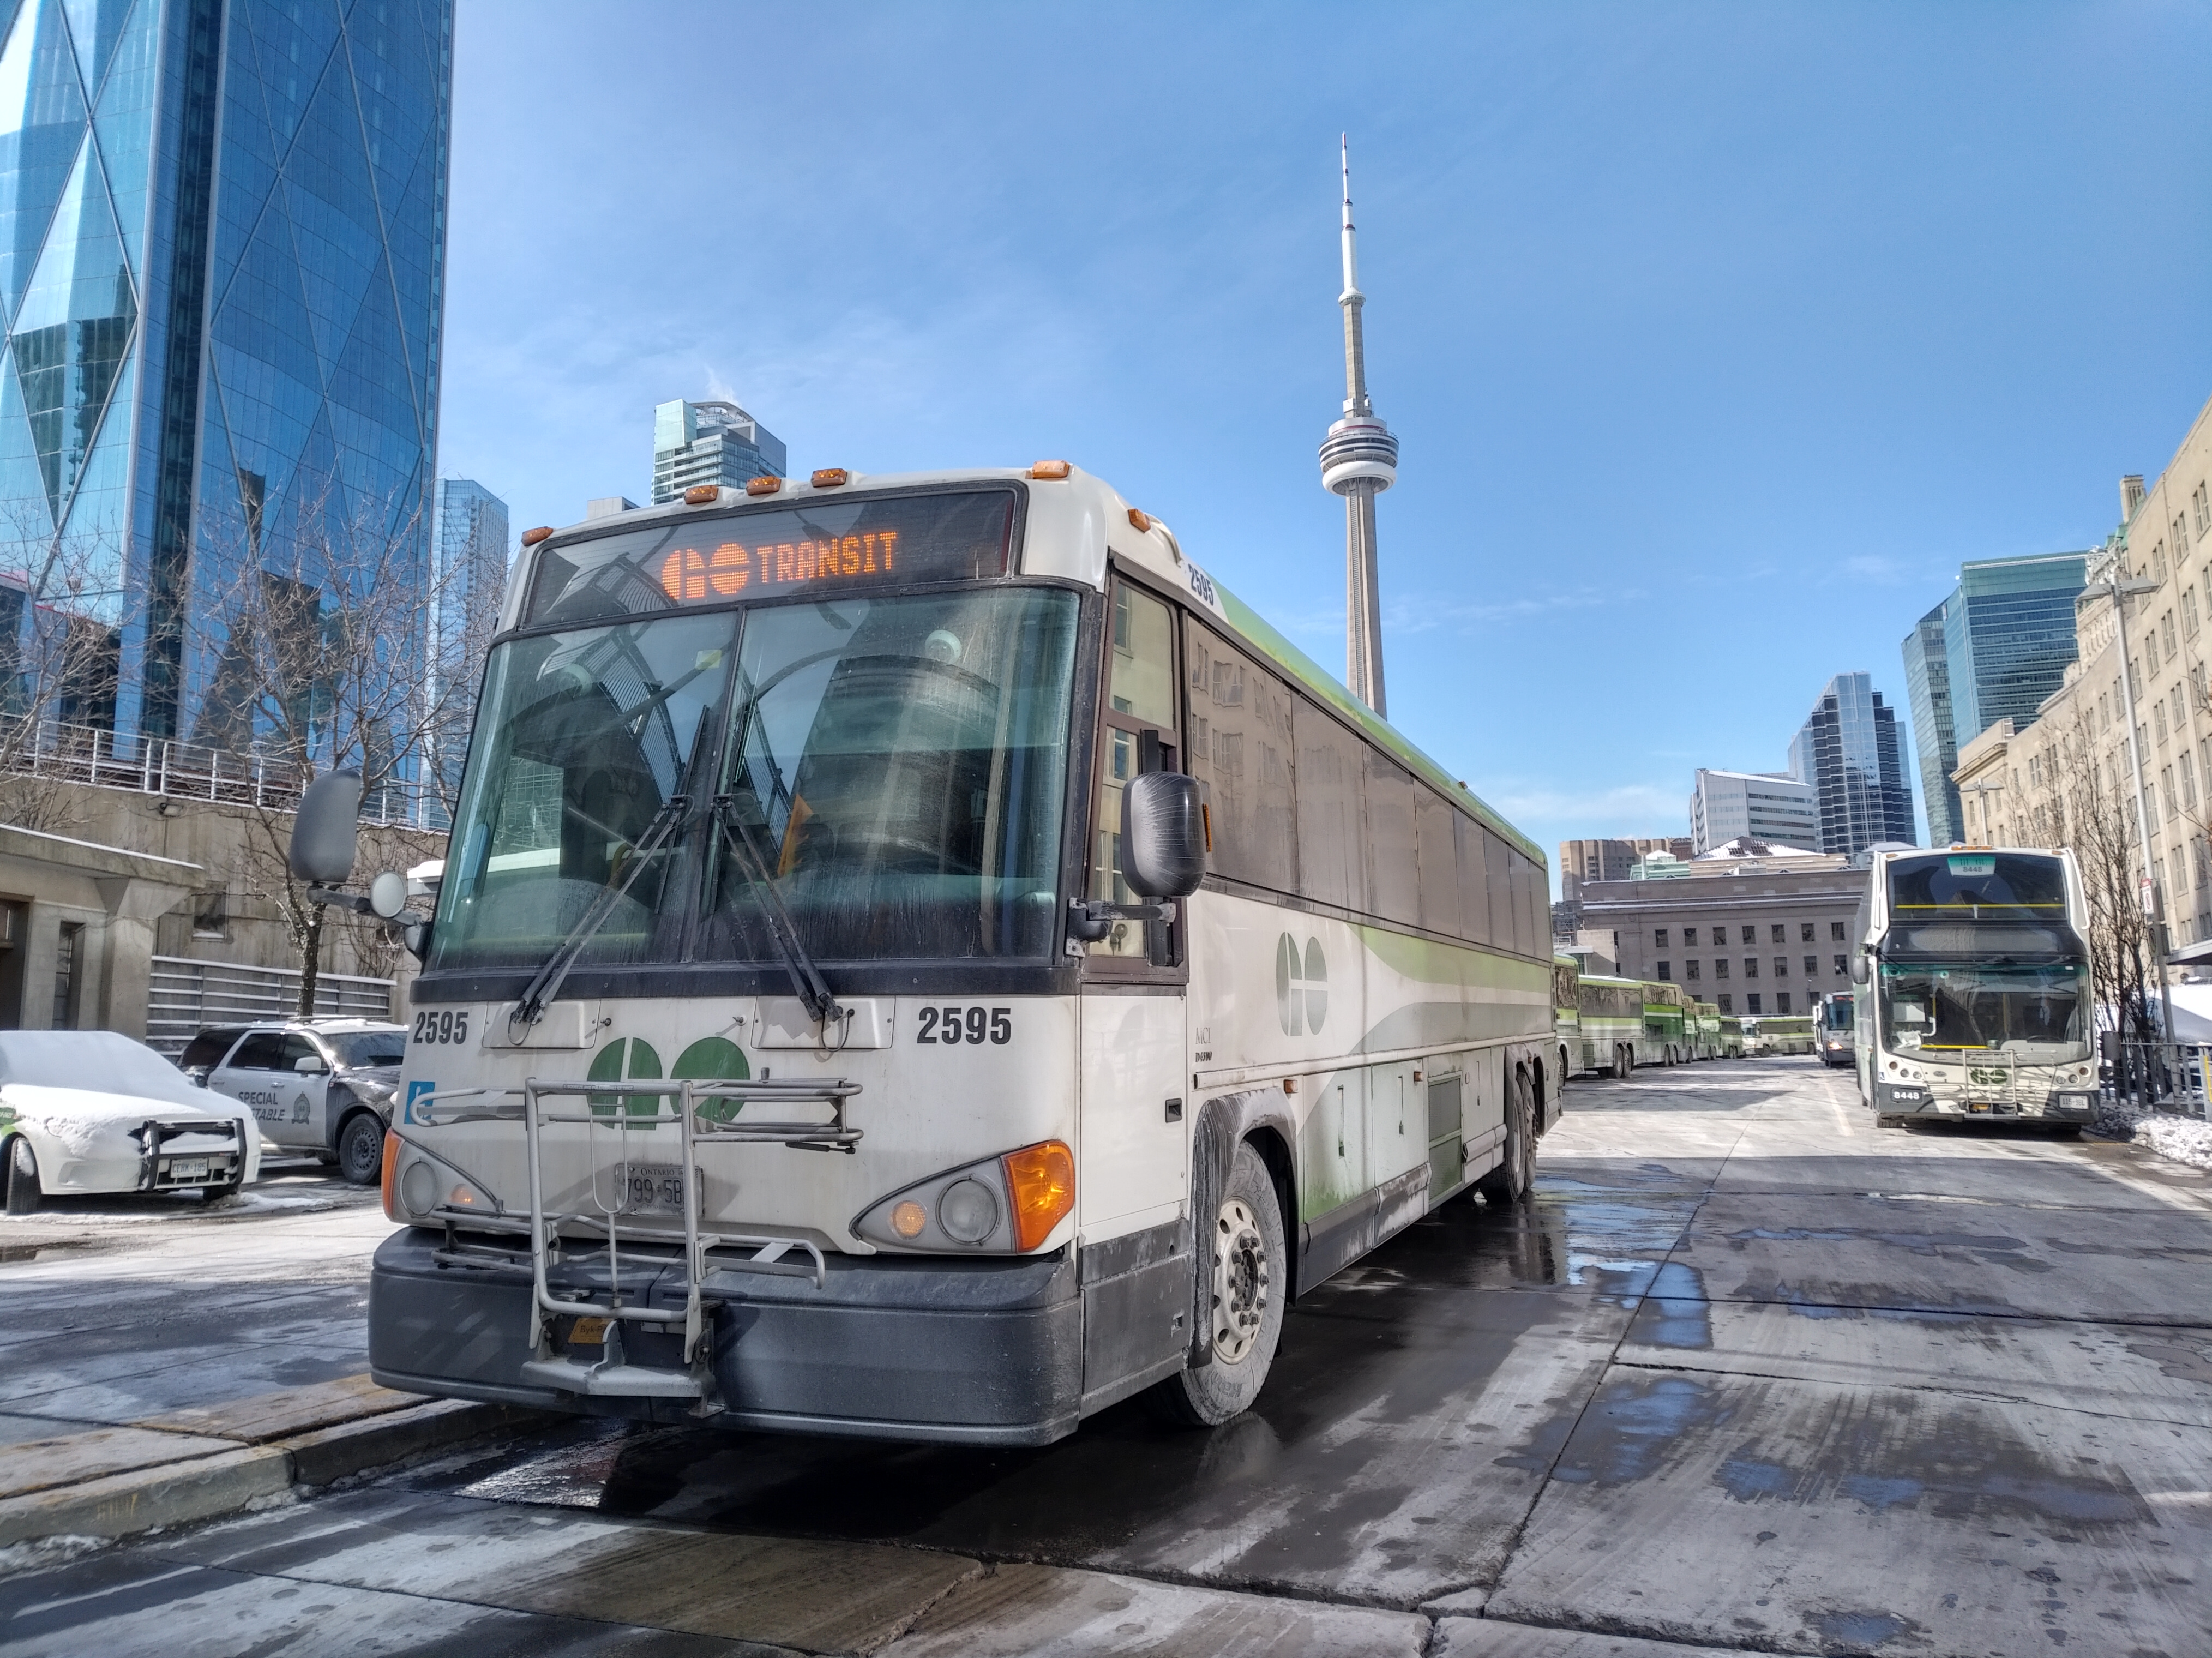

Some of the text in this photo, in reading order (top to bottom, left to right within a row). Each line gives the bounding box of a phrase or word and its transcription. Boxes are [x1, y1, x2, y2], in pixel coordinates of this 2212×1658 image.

[756, 531, 897, 584] TRANSIT
[1188, 563, 1214, 606] 2595
[413, 1011, 468, 1044] 2595
[917, 1006, 1011, 1045] 2595
[1195, 1027, 1211, 1044] MCI
[1195, 1051, 1212, 1062] D4500
[238, 1091, 278, 1105] SPECIAL
[1894, 1091, 1920, 1100] 8448
[251, 1108, 285, 1121] TABLE
[664, 1179, 684, 1204] 5B
